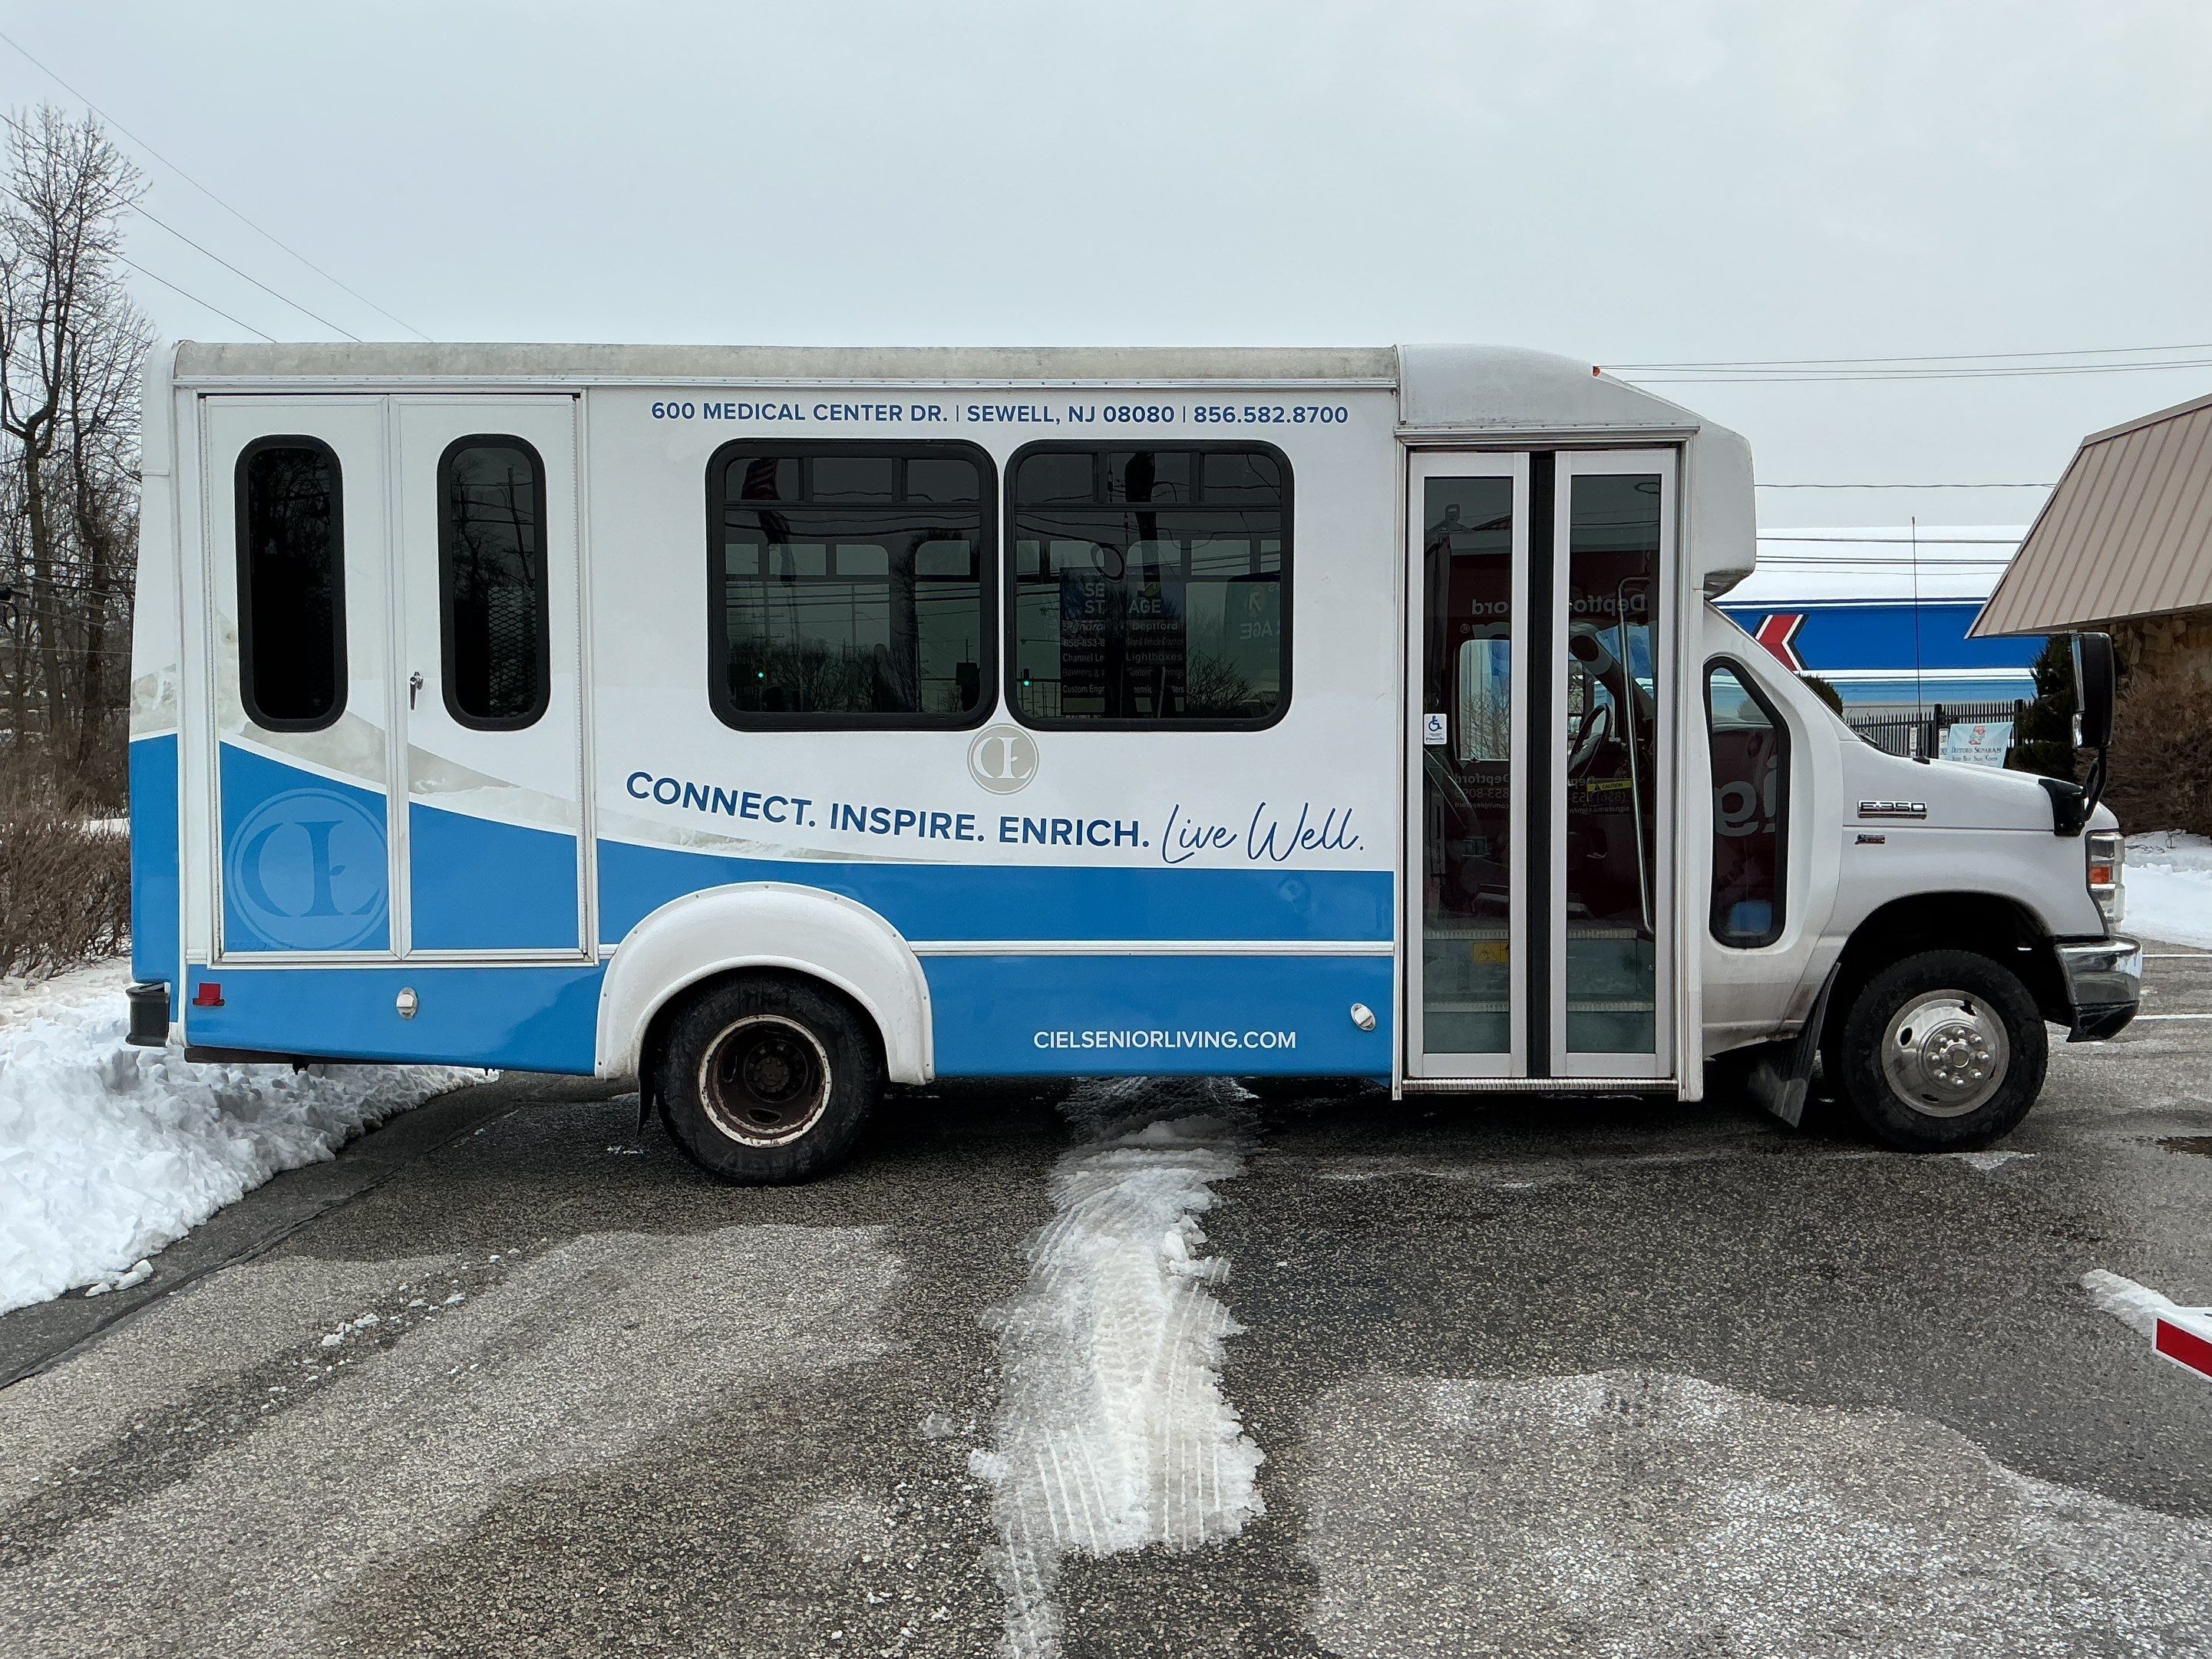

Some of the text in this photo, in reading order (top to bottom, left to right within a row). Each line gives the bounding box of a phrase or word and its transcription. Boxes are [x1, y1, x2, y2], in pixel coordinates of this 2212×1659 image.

[651, 401, 695, 420] 600
[703, 402, 806, 421] MEDICAL
[813, 404, 903, 421] CENTER
[910, 404, 948, 422] DR.
[967, 404, 1061, 425] SEWELL,
[1068, 405, 1095, 423] NJ
[1103, 406, 1175, 423] 08080
[1193, 406, 1349, 424] 856.582.8700
[626, 770, 1365, 865] CONNECT. INSPIRE. ENRICH. Live Well.
[1859, 801, 1927, 813] E-350
[1034, 1031, 1296, 1049] CIELSENIORLIVING.COM
